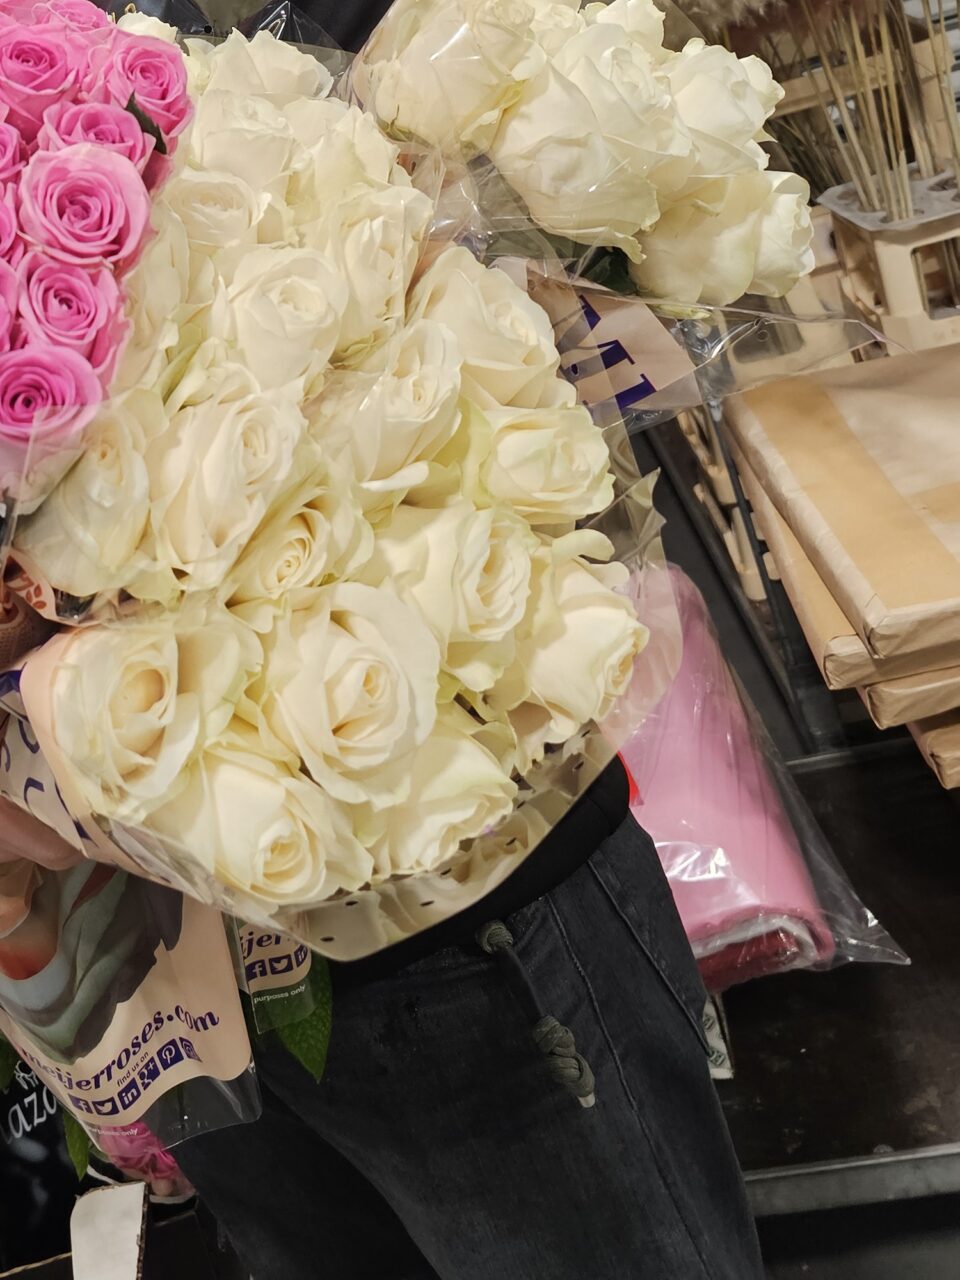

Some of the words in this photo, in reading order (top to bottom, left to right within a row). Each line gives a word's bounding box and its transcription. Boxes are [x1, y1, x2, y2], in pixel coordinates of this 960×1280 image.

[290, 983, 306, 995] only
[116, 1071, 131, 1087] find
[131, 1063, 140, 1073] us
[140, 1052, 149, 1063] on
